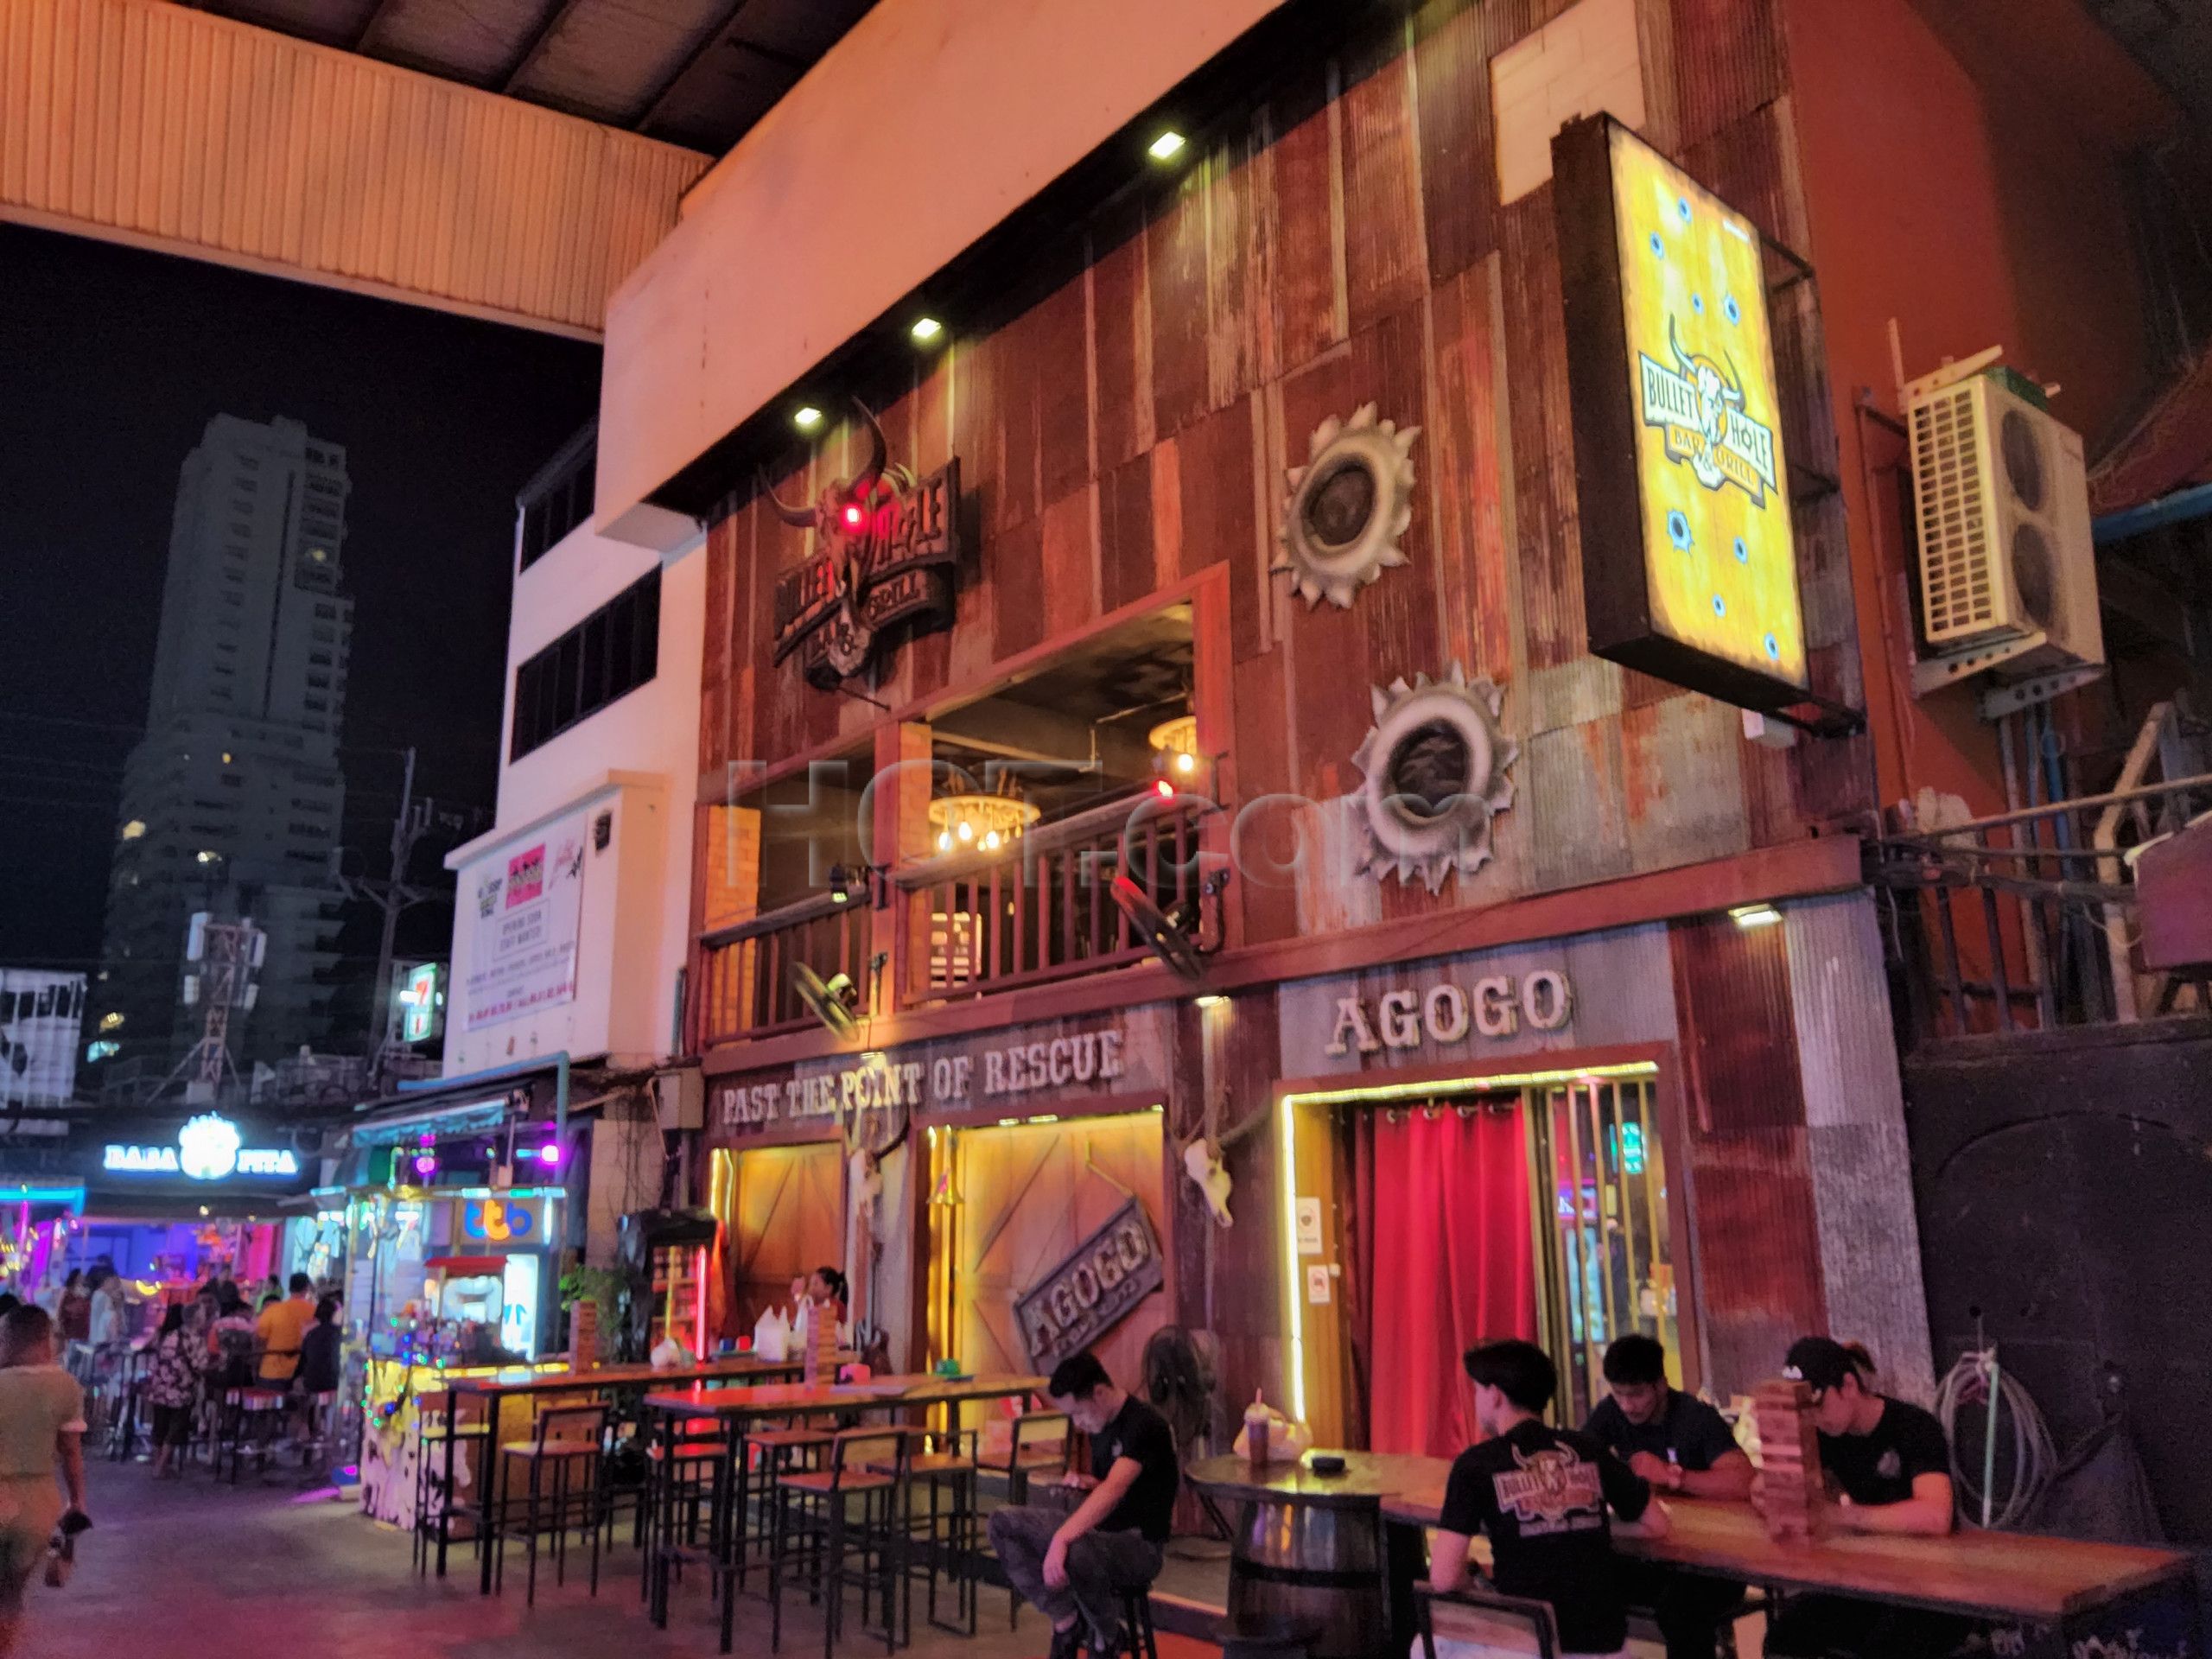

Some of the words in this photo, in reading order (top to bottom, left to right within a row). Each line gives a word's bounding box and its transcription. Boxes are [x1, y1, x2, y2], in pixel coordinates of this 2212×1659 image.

[1646, 365, 1693, 420] BULLET
[1730, 413, 1769, 472] HOLE
[1674, 428, 1703, 461] BAR
[1715, 448, 1752, 486] GRILL
[1325, 969, 1573, 1056] AGOGO
[724, 1084, 779, 1124] PAST
[787, 1075, 836, 1116] THE
[840, 1060, 922, 1111] POINT
[933, 1056, 972, 1098] OF
[984, 1029, 1122, 1095] RESCUE
[1018, 1220, 1150, 1357] AGOGO
